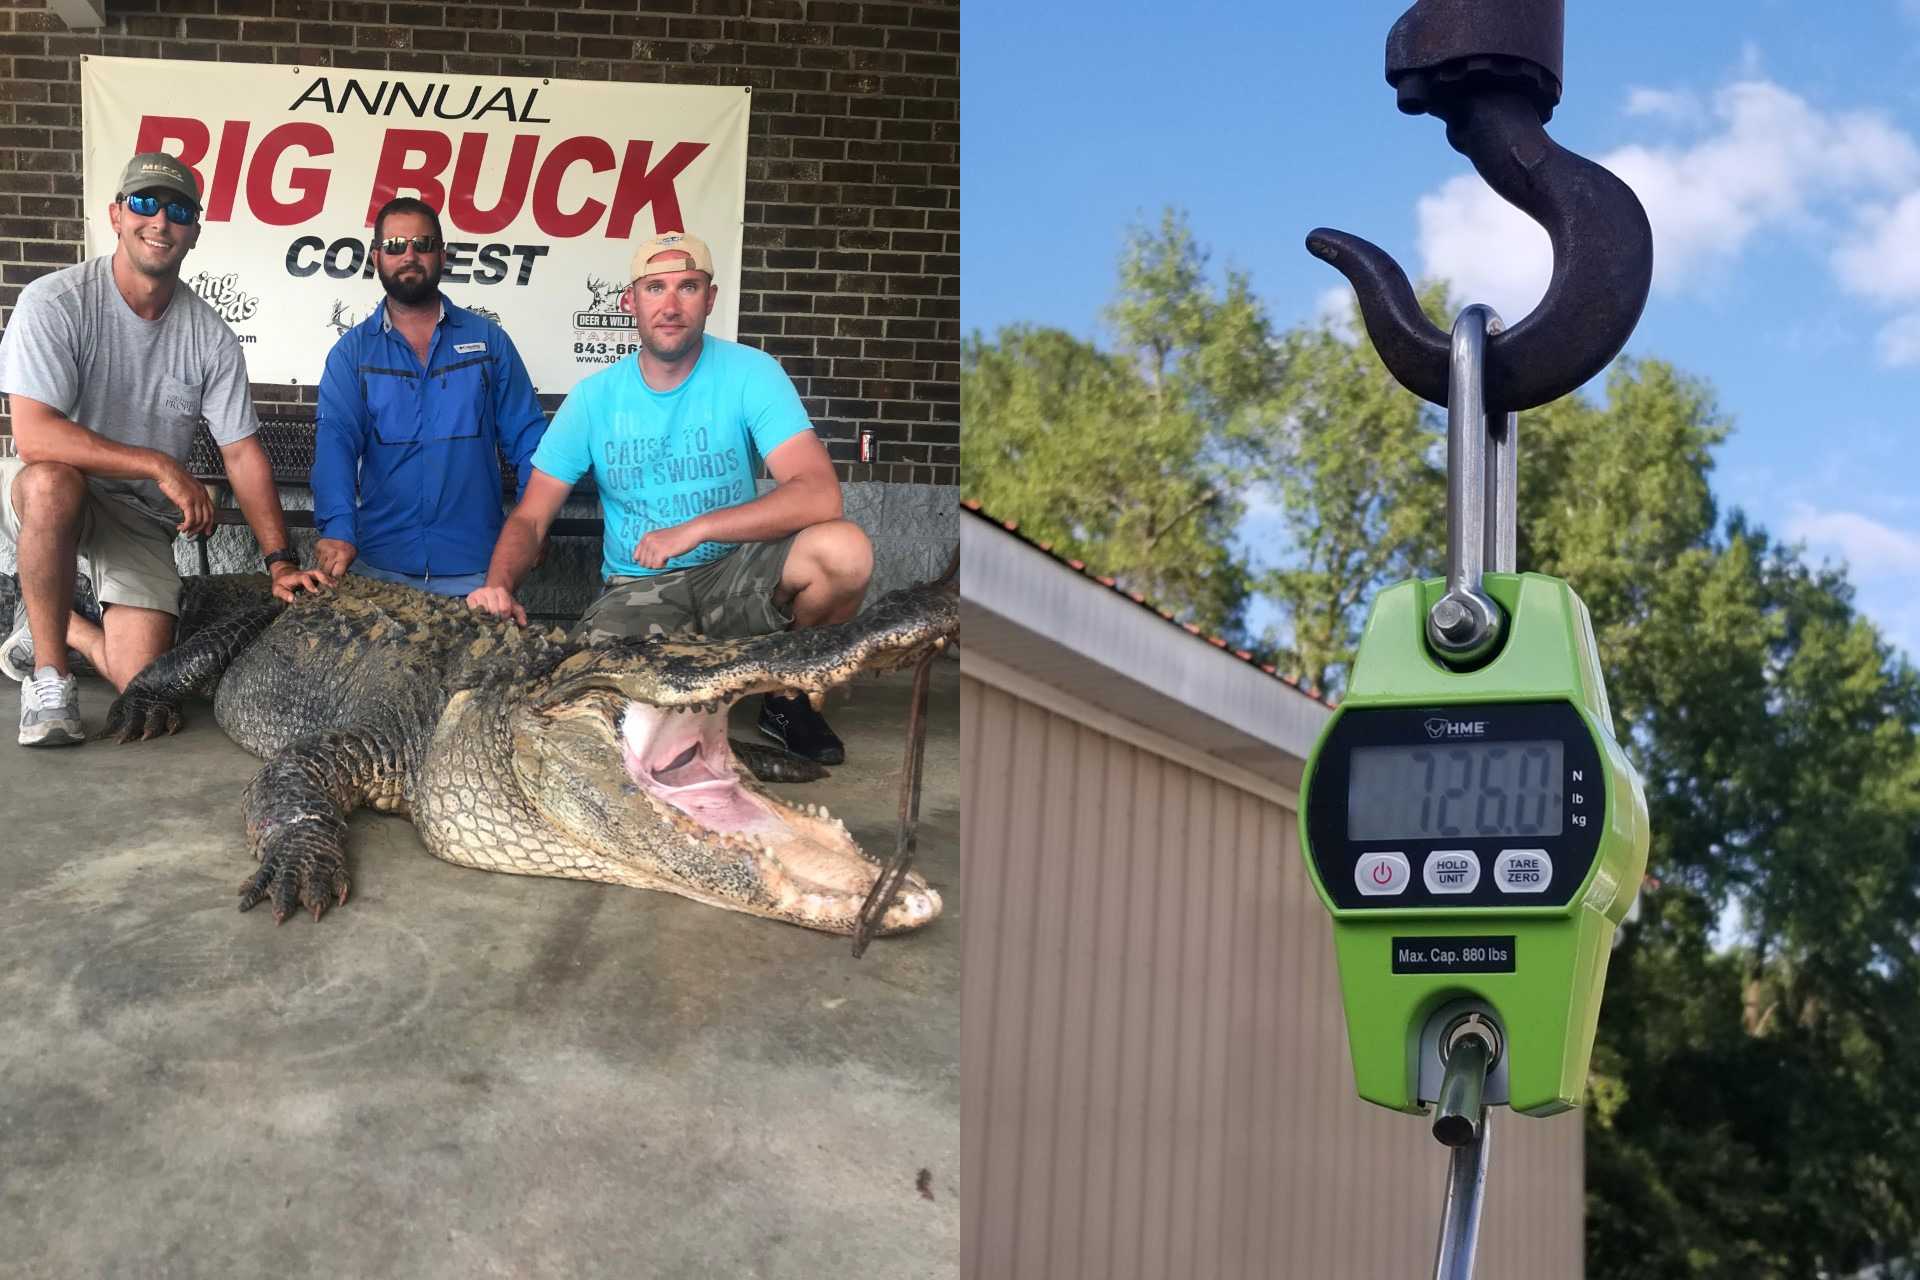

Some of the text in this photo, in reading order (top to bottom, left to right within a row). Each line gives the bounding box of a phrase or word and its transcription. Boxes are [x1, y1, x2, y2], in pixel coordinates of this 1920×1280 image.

[288, 77, 551, 124] ANNUAL
[134, 115, 711, 239] BIG BUCK
[285, 235, 550, 286] COEST
[189, 270, 239, 305] ting
[579, 315, 600, 326] DEER
[601, 316, 608, 326] &
[609, 316, 630, 326] WILD
[237, 334, 257, 343] om
[574, 331, 641, 342] TAXID
[574, 342, 643, 354] 843-66
[604, 426, 709, 466] CAUSE TO
[653, 447, 741, 486] SWORDS
[1447, 721, 1485, 735] HME
[1572, 770, 1583, 781] N
[1572, 793, 1584, 804] lb
[1572, 813, 1587, 827] kg
[1436, 860, 1468, 870] HOLD
[1509, 859, 1538, 868] TARE
[1439, 874, 1465, 883] UNIT
[1507, 872, 1540, 883] ZERO
[1399, 947, 1508, 965] Max. Cap. 880 lbs
